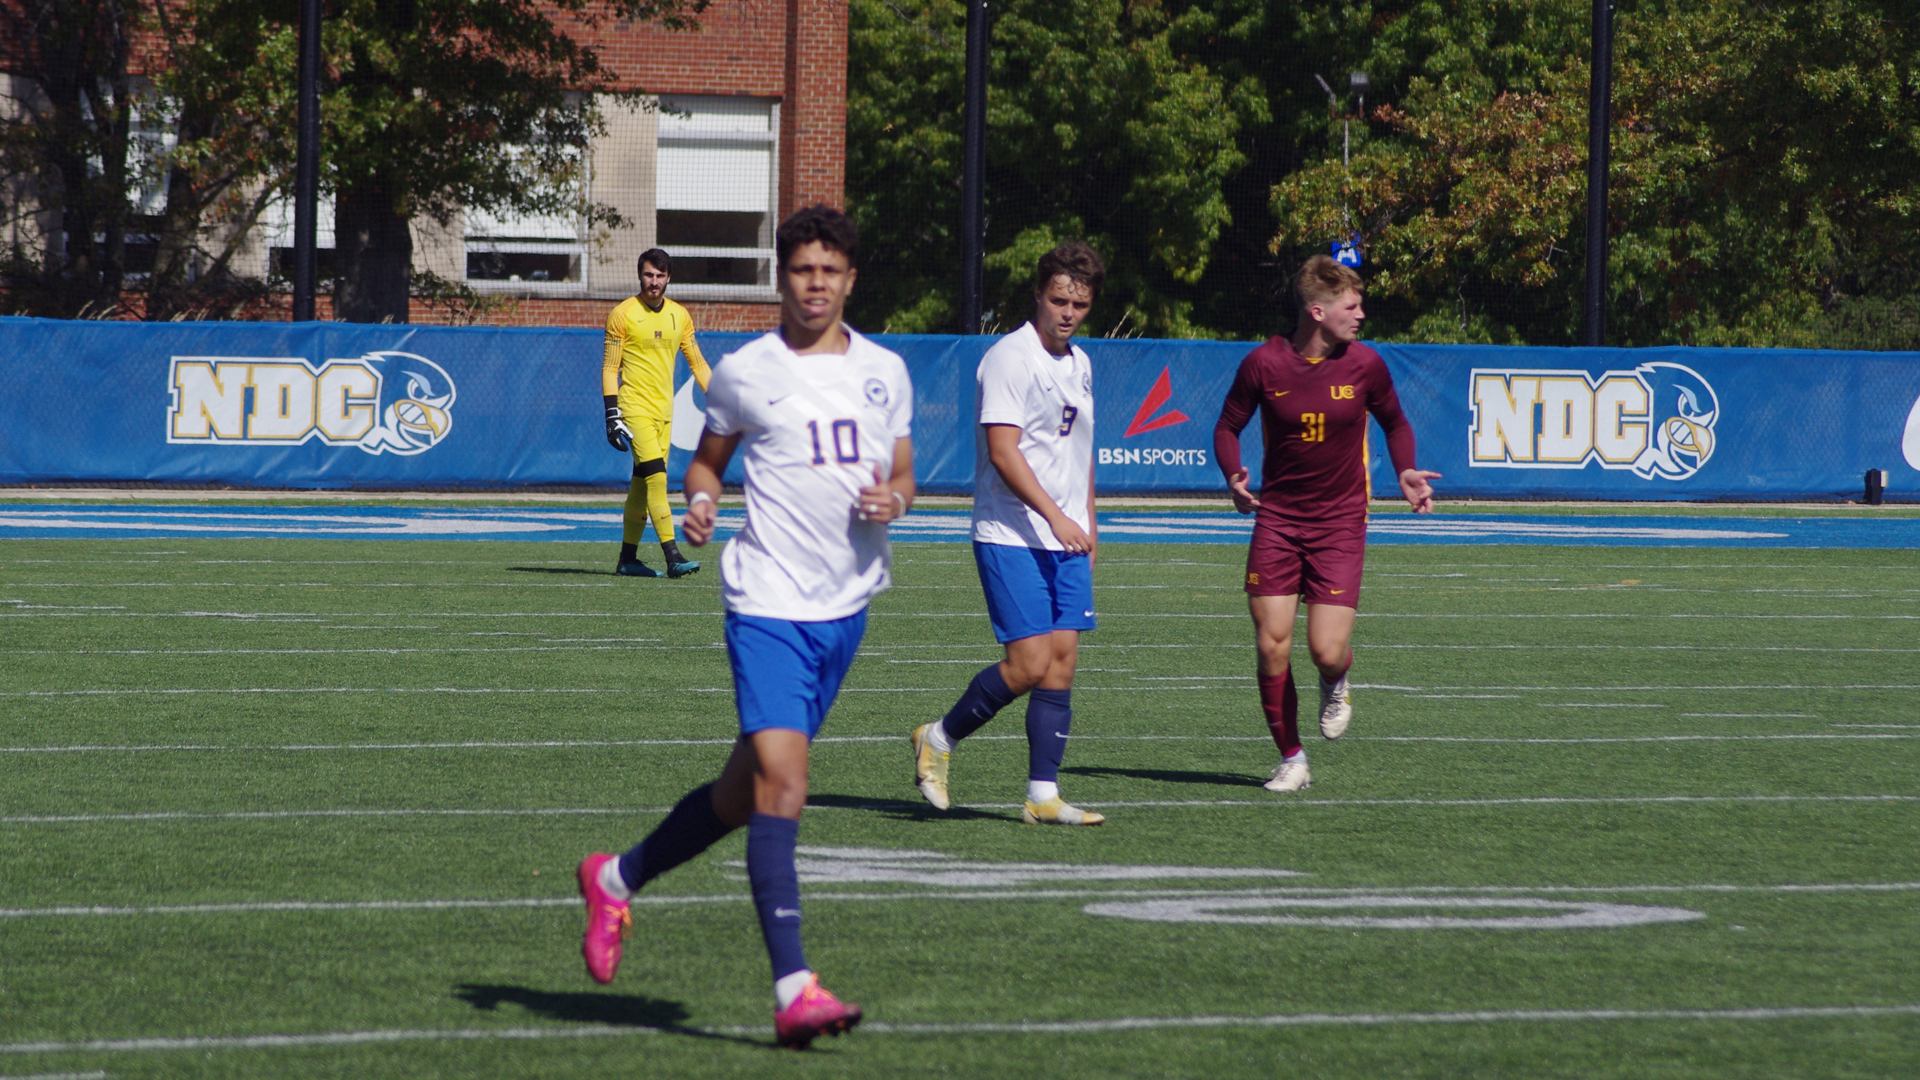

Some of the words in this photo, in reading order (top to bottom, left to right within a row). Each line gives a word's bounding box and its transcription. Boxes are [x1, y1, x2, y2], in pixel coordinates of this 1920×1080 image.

[670, 312, 676, 331] 1
[172, 361, 378, 441] NDC
[1330, 384, 1355, 400] UC
[1059, 404, 1078, 437] 9
[1301, 412, 1325, 442] 31
[1473, 375, 1650, 463] NDC
[807, 418, 860, 465] 10
[1098, 448, 1141, 465] BSN
[1142, 448, 1207, 466] SPORTS
